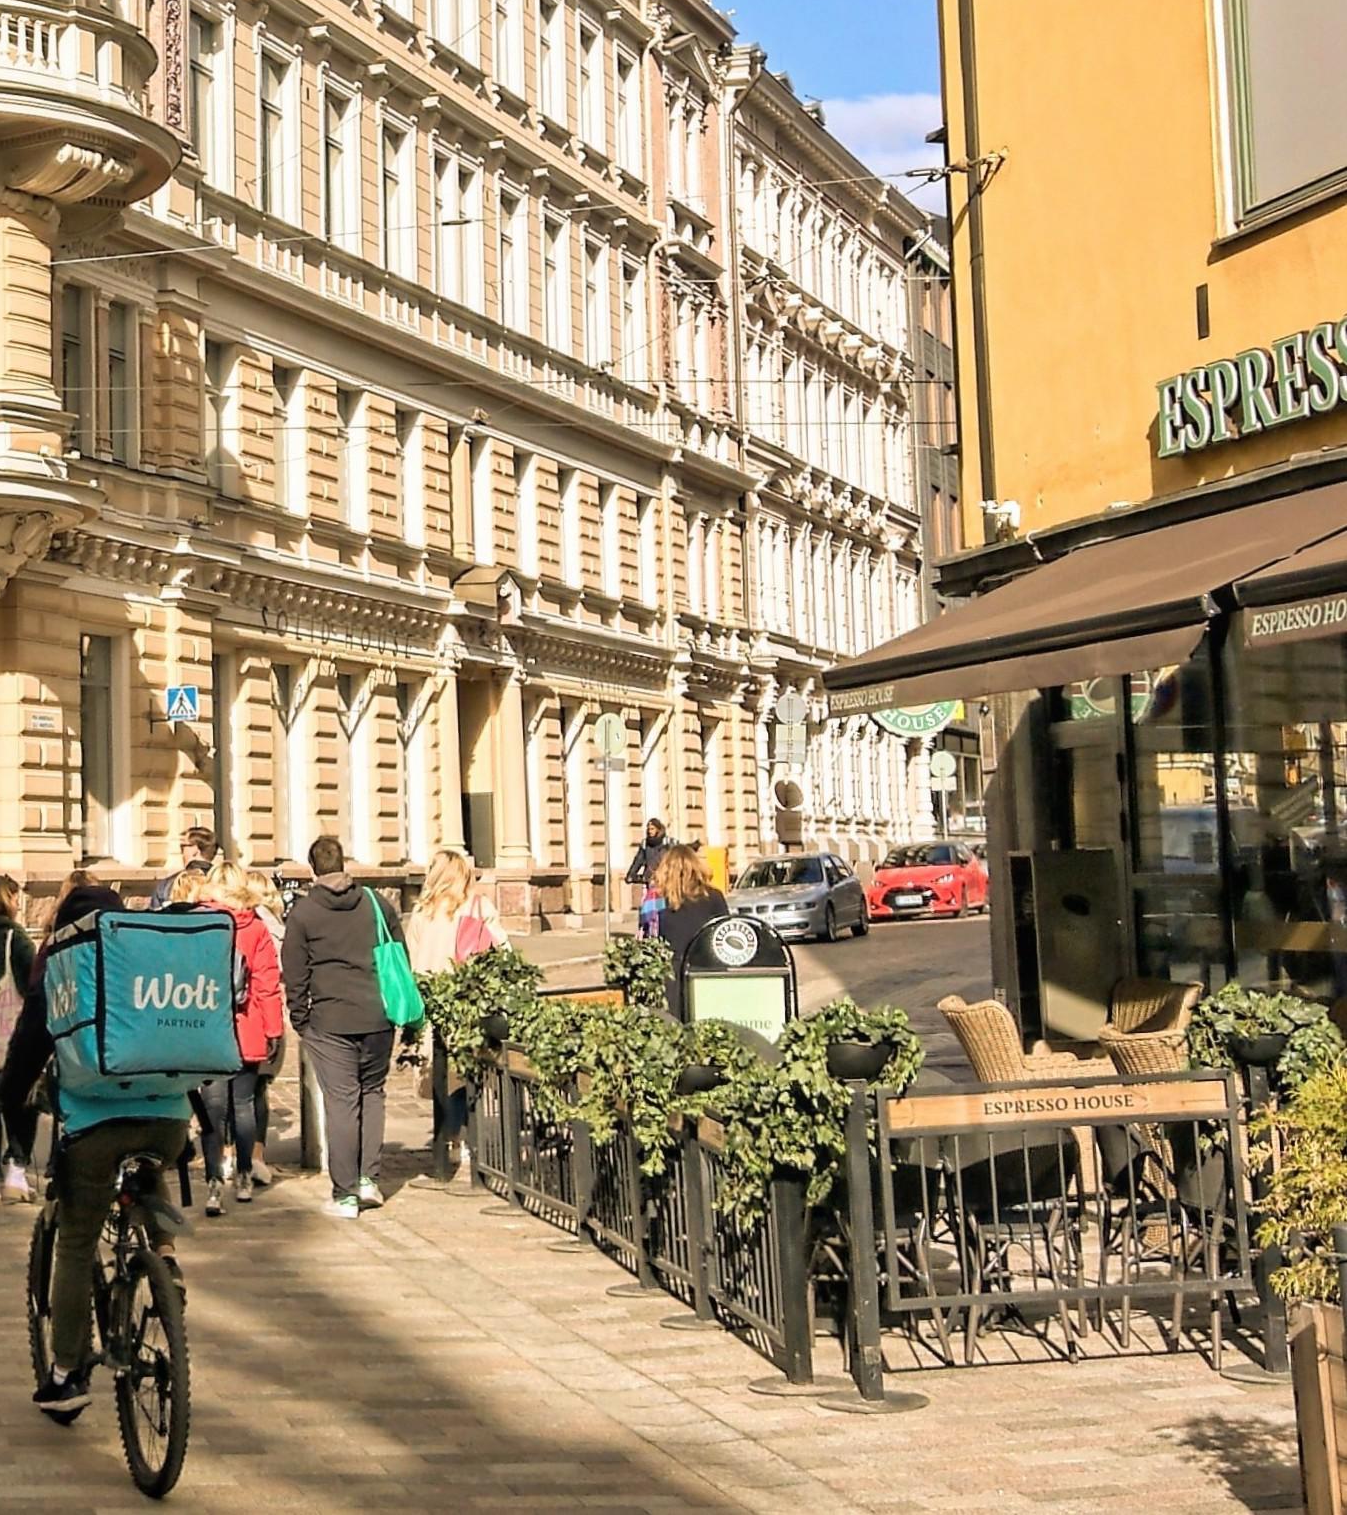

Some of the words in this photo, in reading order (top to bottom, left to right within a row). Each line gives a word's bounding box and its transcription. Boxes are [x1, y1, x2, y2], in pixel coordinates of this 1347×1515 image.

[261, 606, 332, 645] SOLID
[344, 623, 413, 659] HOUSE
[1251, 604, 1322, 637] ESPRESSO
[830, 688, 867, 711] ESPRESSO
[881, 704, 947, 730] HOUSE
[133, 973, 220, 1011] Wolt
[157, 1018, 206, 1029] PARTNER
[983, 1097, 1068, 1116] ESPRESSO
[1074, 1093, 1135, 1110] HOUSE
